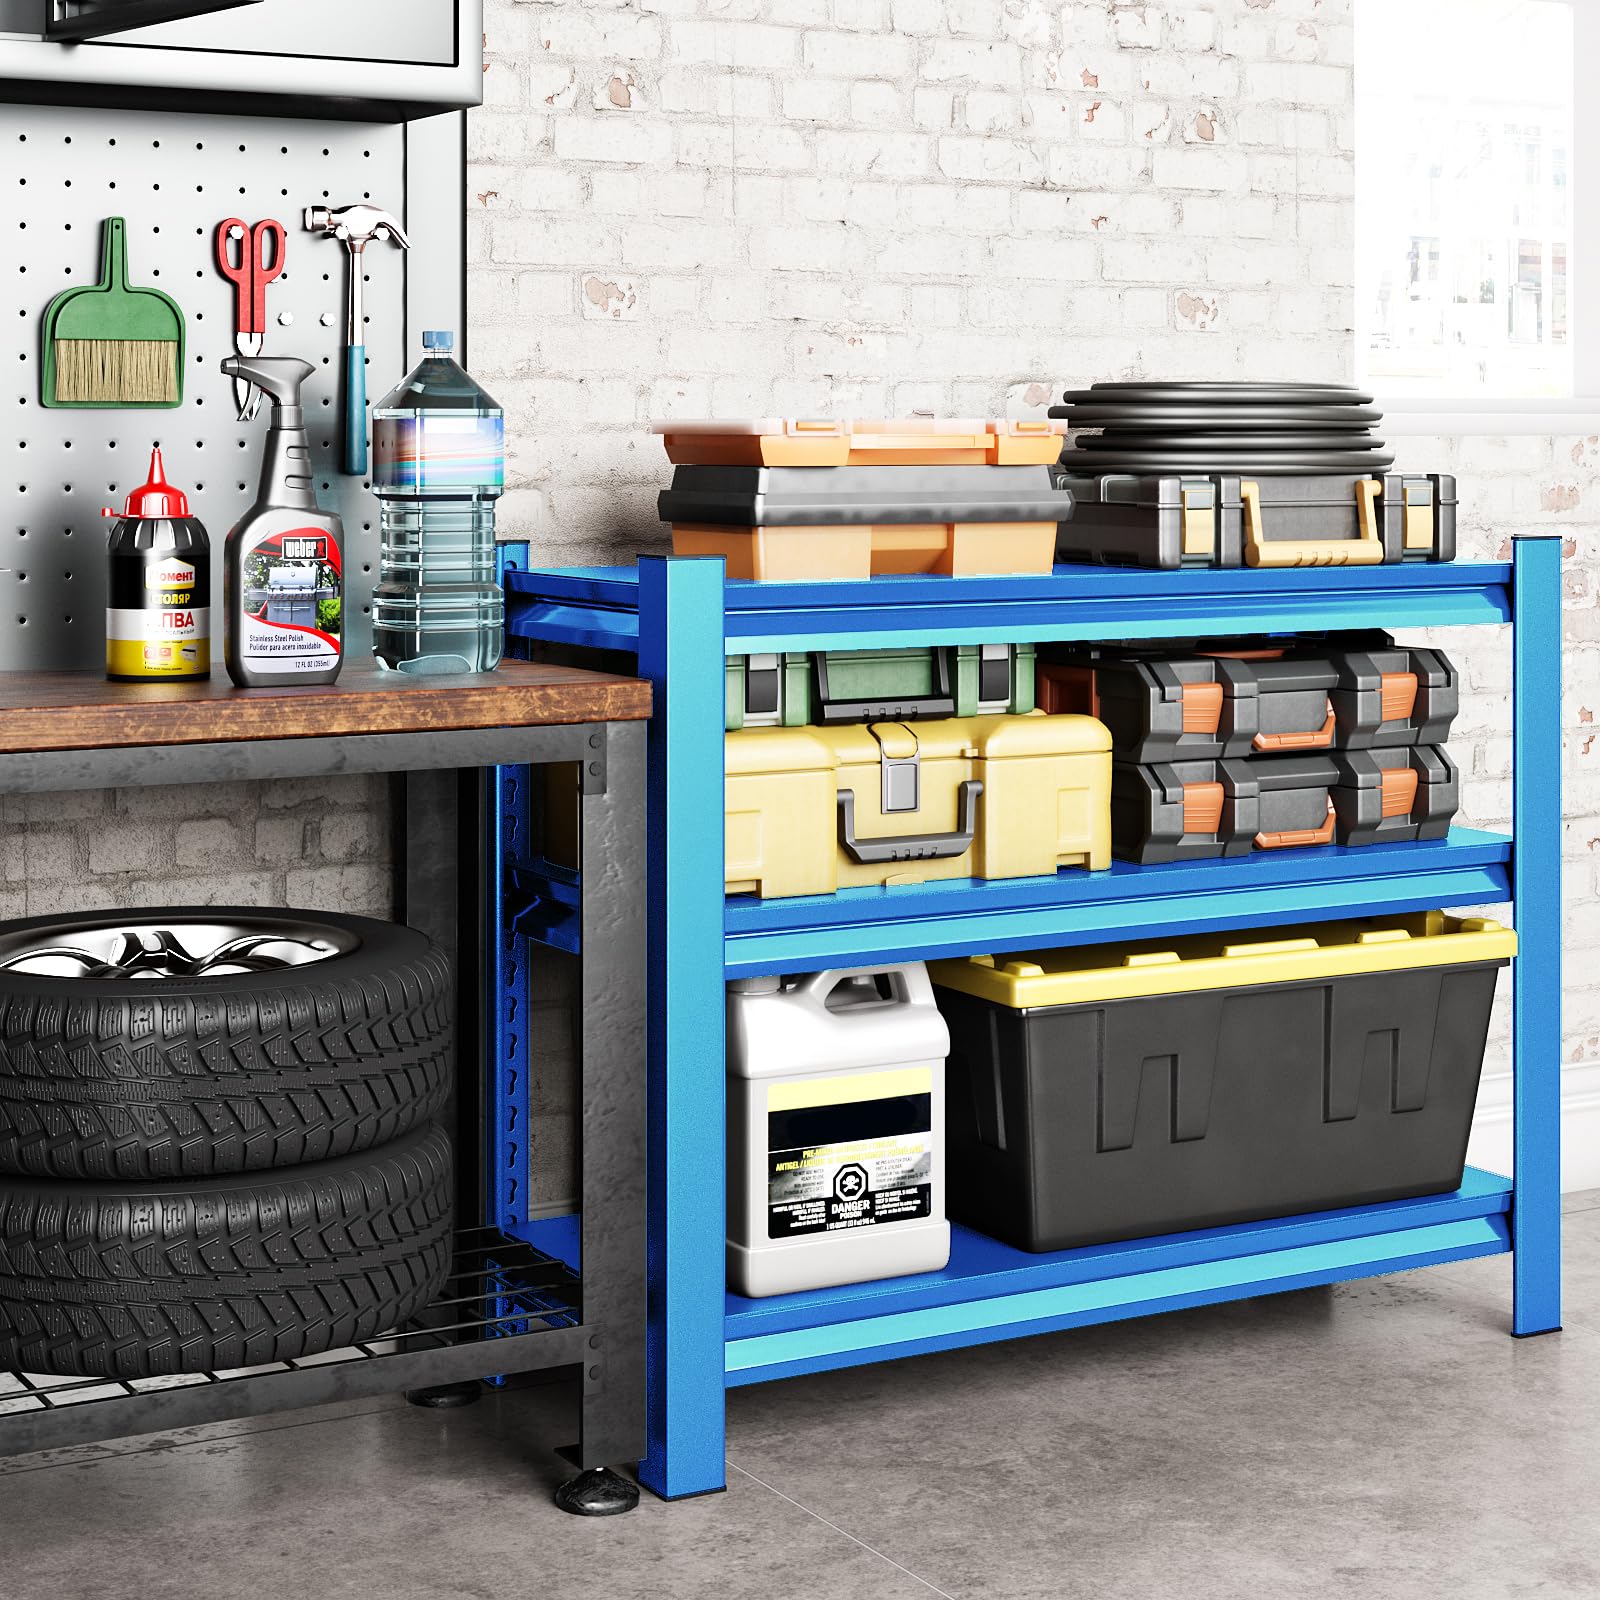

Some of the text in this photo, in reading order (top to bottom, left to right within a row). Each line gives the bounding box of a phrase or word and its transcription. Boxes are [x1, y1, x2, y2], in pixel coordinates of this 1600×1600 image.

[285, 539, 317, 558] weber
[150, 570, 194, 582] омент
[249, 634, 304, 642] Stainless Steel Polish
[249, 643, 268, 651] Pulidor
[269, 644, 281, 652] para
[296, 642, 322, 650] inoxidable
[831, 1199, 870, 1214] DANGER
[839, 1210, 862, 1219] POISON
